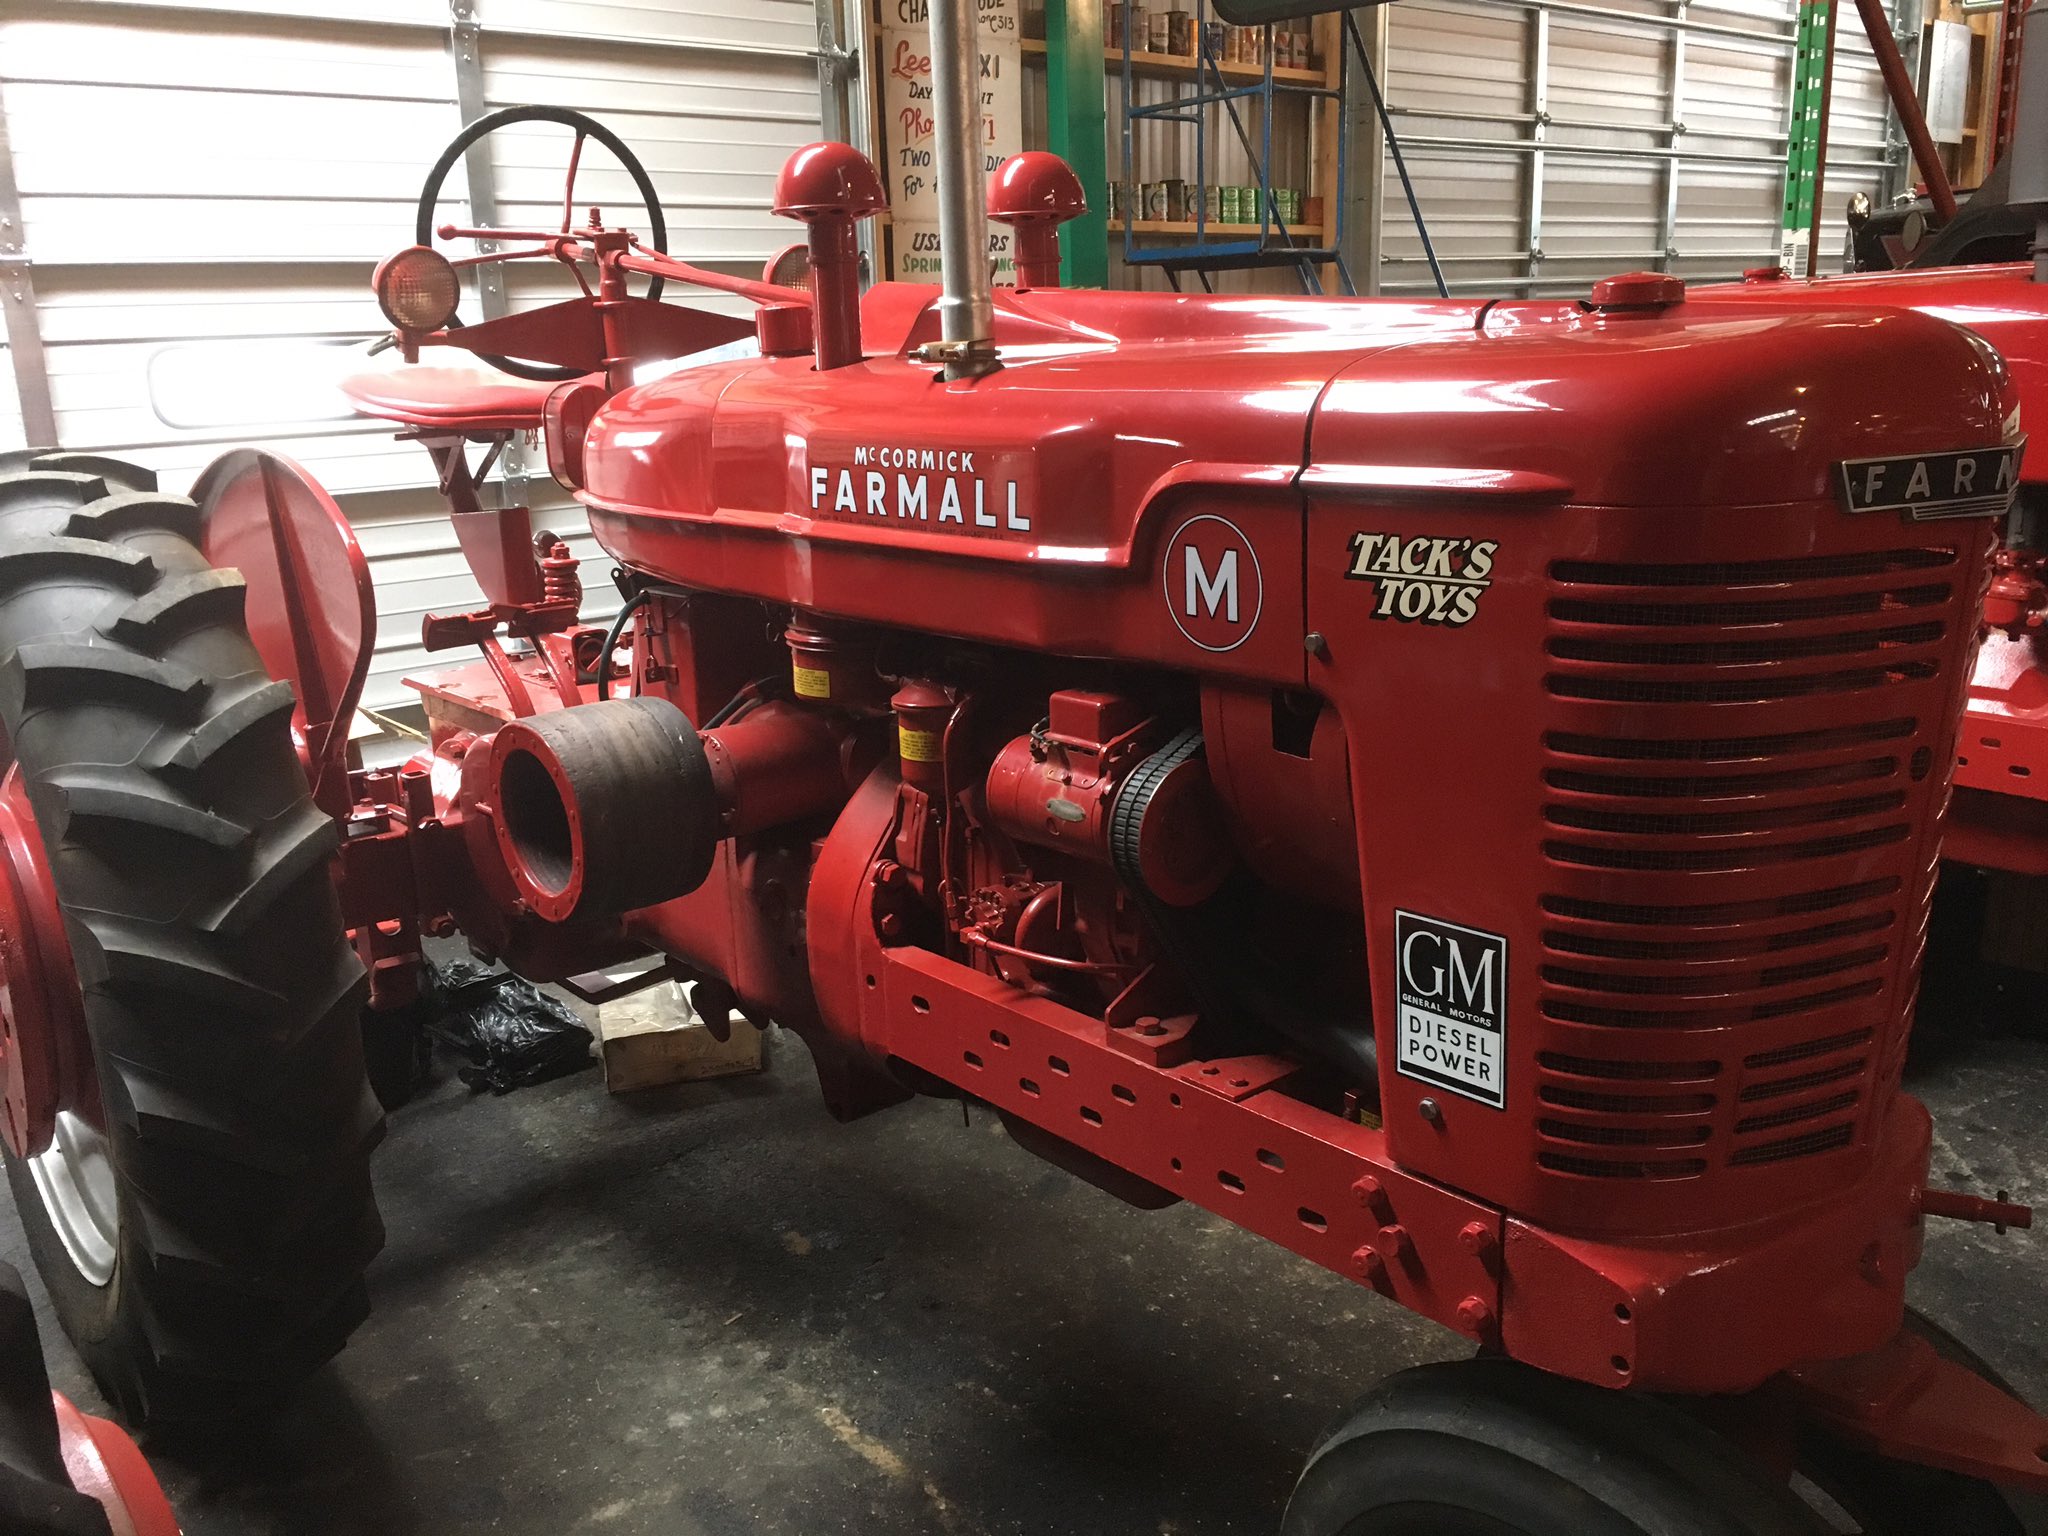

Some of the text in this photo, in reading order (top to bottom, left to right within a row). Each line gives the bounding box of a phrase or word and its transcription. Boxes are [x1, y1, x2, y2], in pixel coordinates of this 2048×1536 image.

[997, 15, 1015, 30] 313
[909, 82, 933, 100] DAY
[900, 148, 931, 167] TWO
[810, 466, 1031, 532] FARMALL
[1350, 531, 1500, 580] TACK'S
[1184, 545, 1239, 624] M
[1375, 576, 1484, 624] TOYS
[1402, 930, 1497, 1015] GM
[1402, 993, 1492, 1027] GENERAL MOTORS
[1409, 1014, 1492, 1058] DIESEL
[1409, 1038, 1491, 1082] POWER
